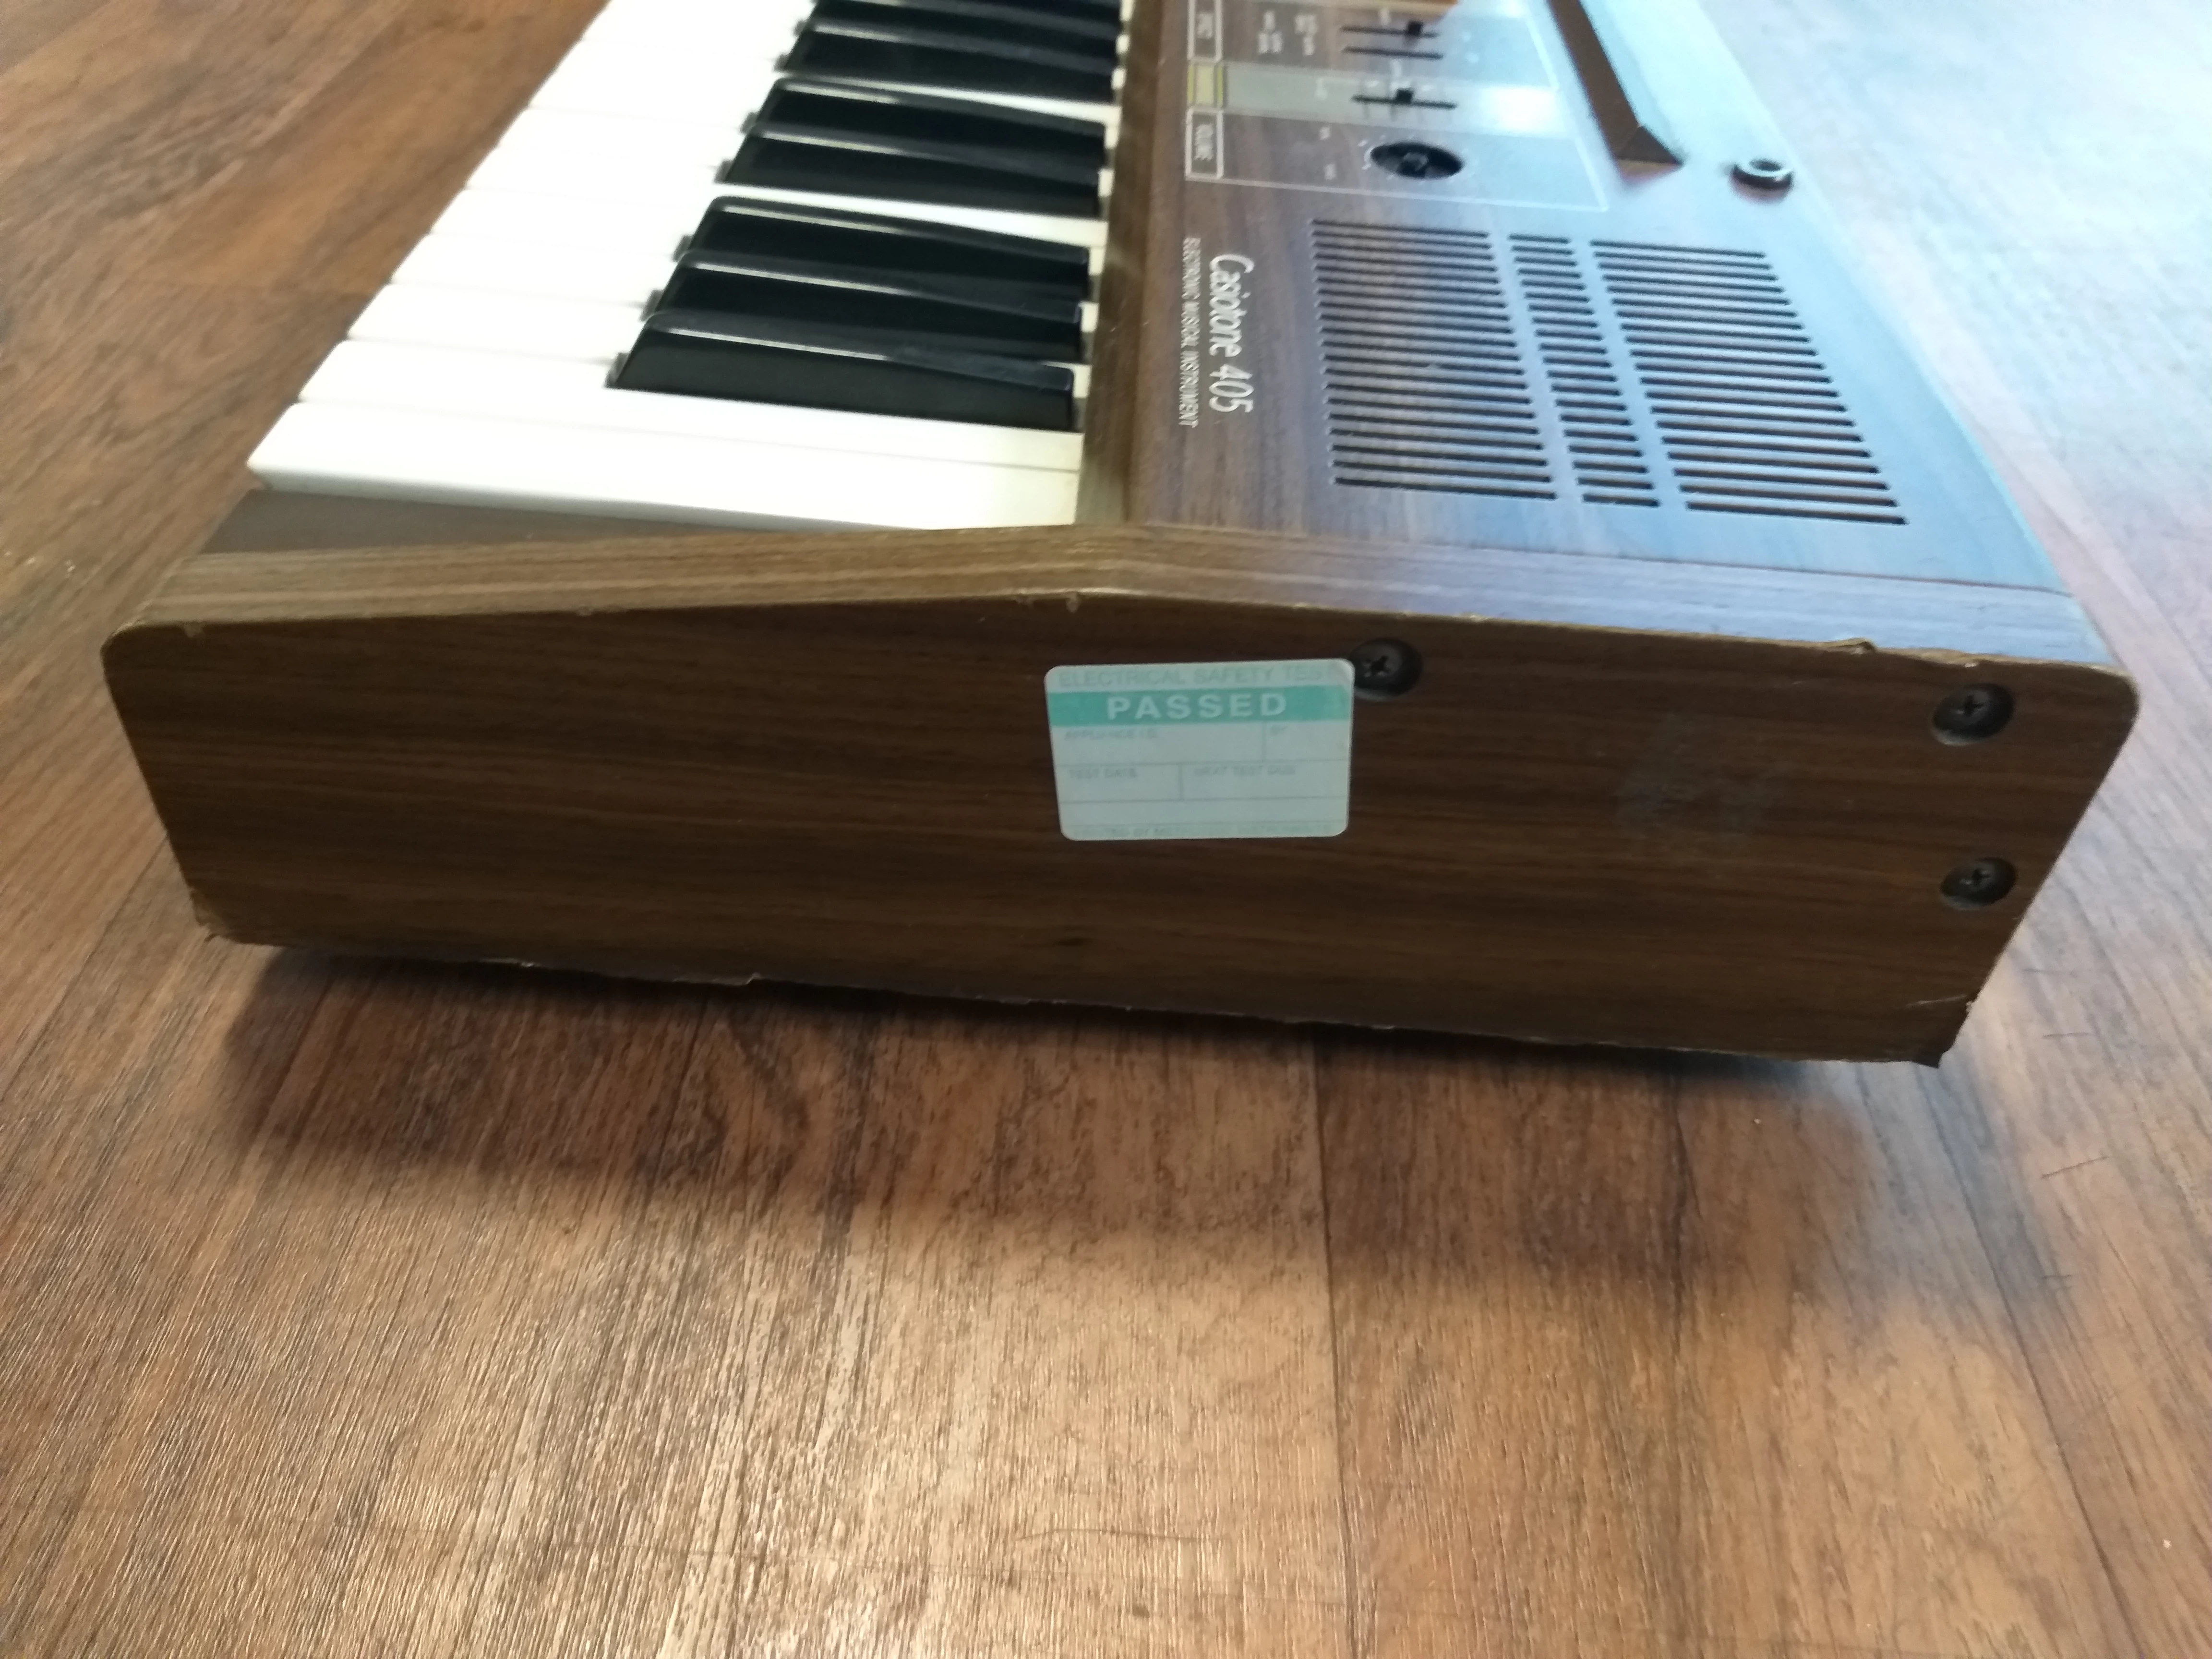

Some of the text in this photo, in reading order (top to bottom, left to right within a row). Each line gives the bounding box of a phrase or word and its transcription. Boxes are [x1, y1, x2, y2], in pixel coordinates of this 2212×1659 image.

[1178, 238, 1201, 428] ELECTRONIC MUSICAL INSTRUMENT
[1209, 254, 1254, 413] Casiotone 405
[1059, 669, 1185, 688] ELECTRICAL
[1192, 666, 1274, 685] SAFETY
[1106, 692, 1287, 721] PASSED
